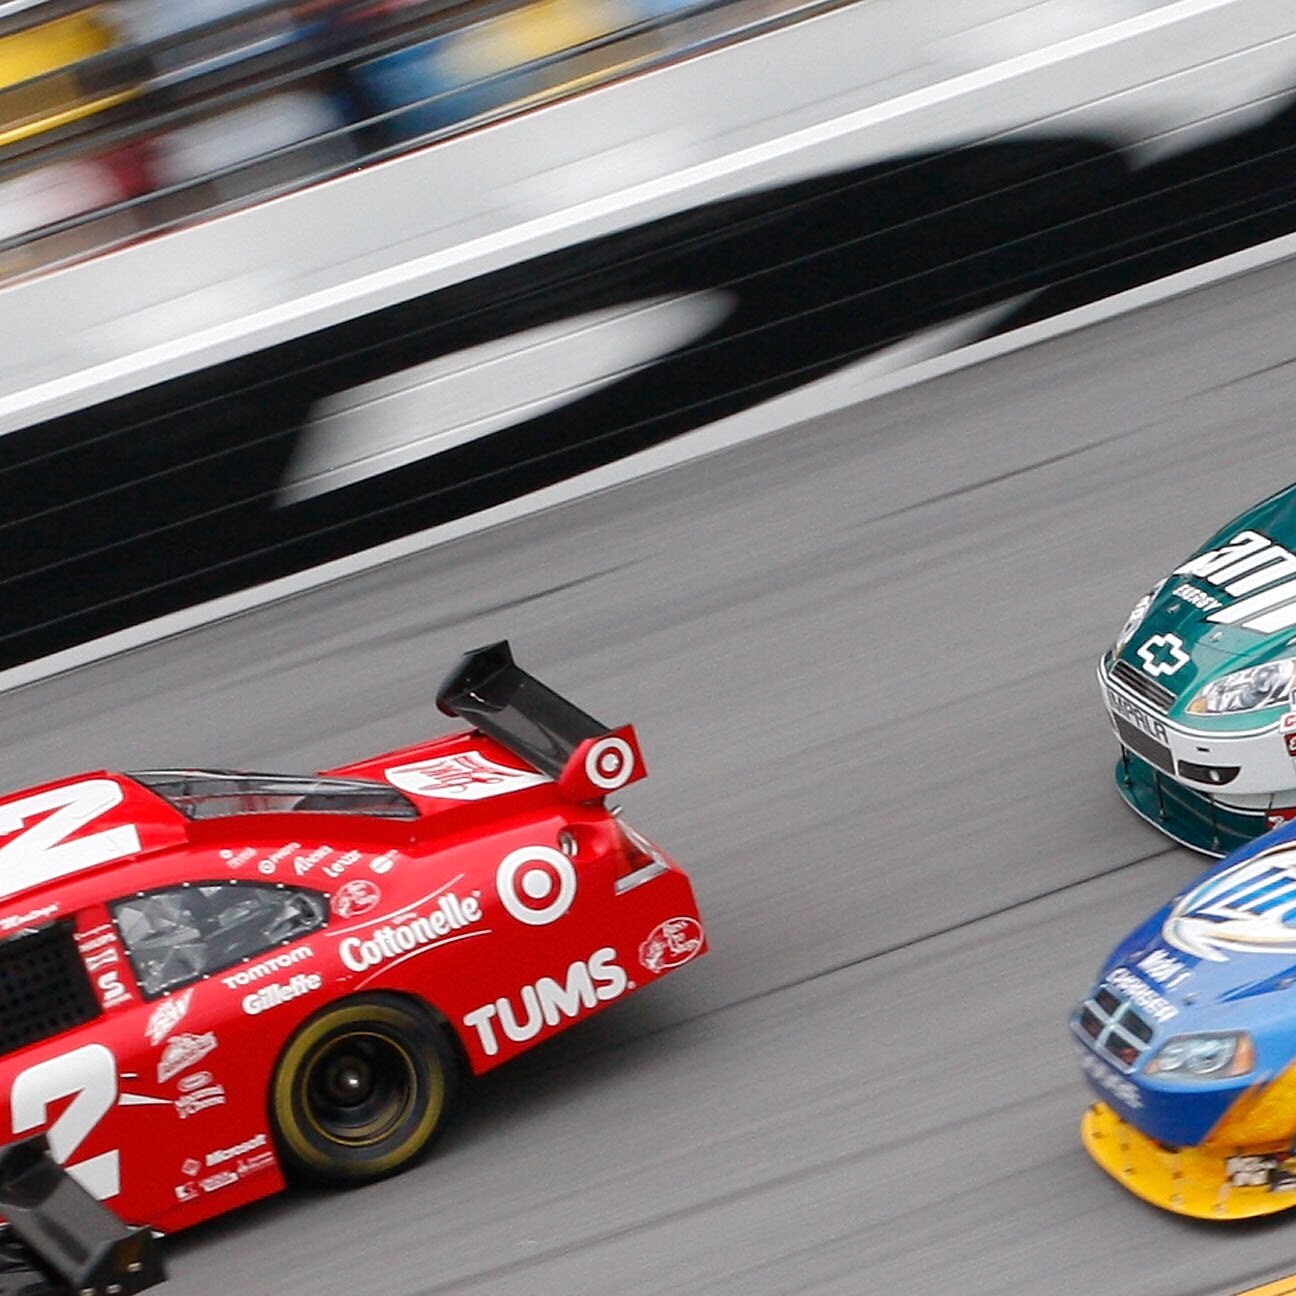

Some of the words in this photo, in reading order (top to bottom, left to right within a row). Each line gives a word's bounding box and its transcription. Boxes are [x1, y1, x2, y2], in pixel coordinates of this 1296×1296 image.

[338, 892, 481, 973] Cottonelle
[242, 973, 323, 1015] Gillette
[464, 947, 627, 1056] TUMS
